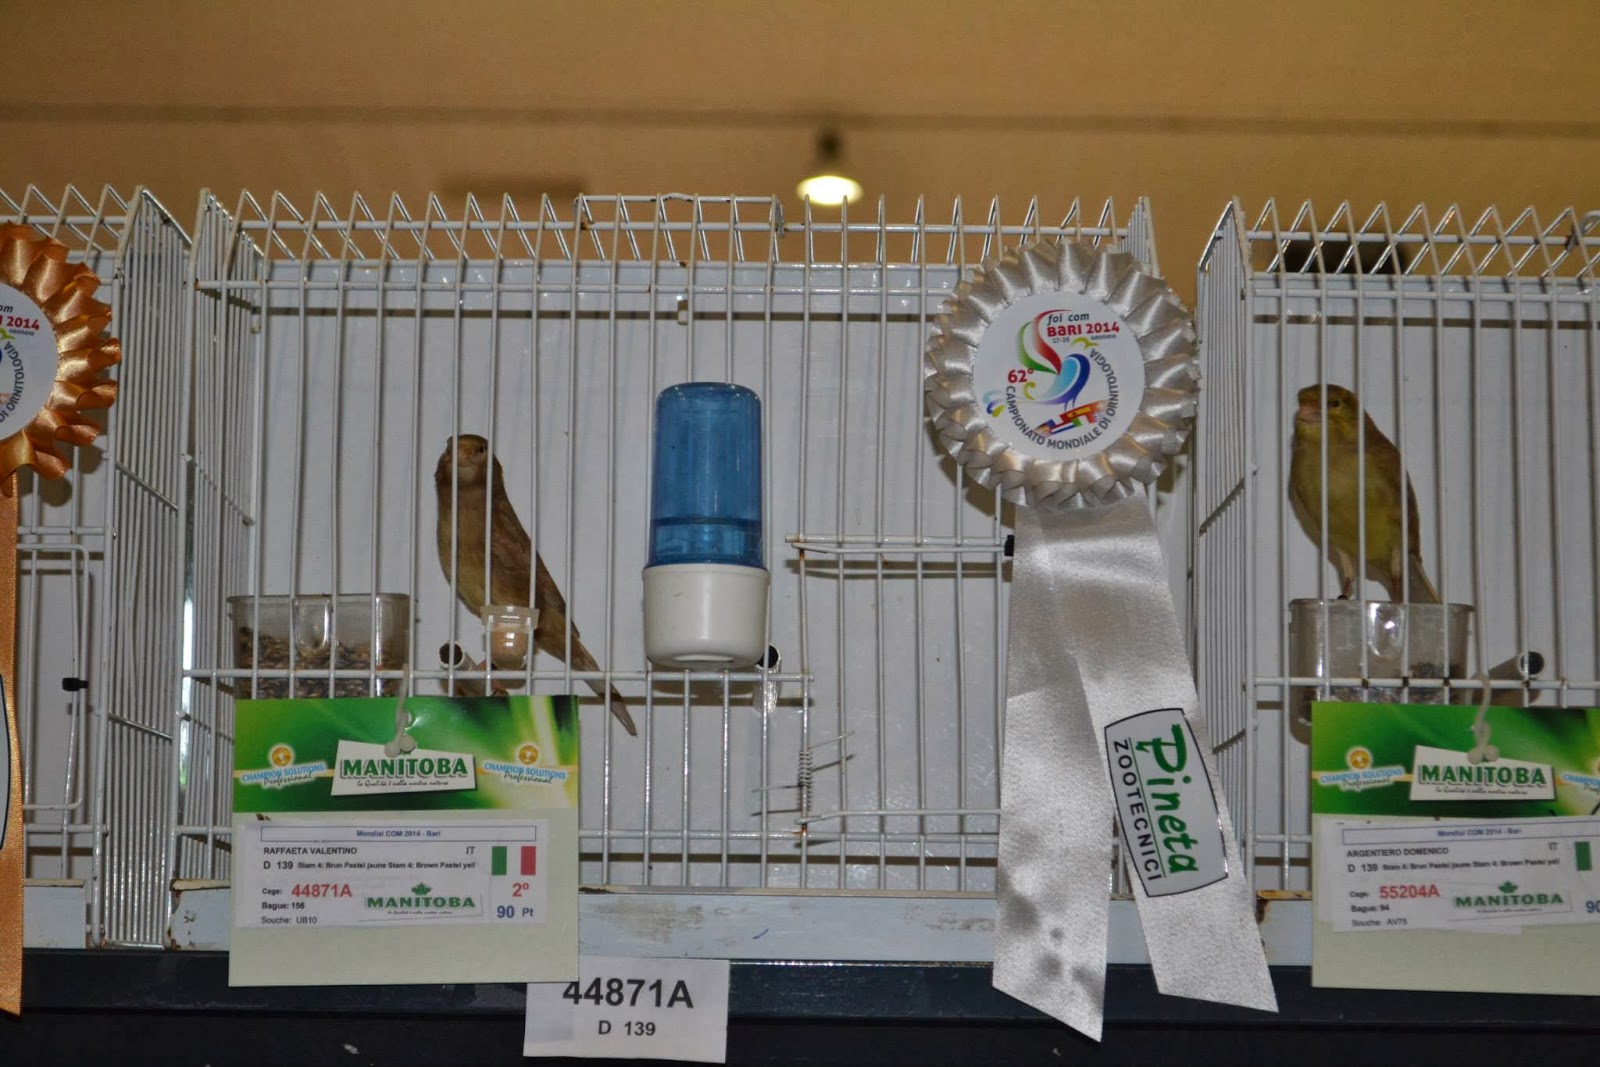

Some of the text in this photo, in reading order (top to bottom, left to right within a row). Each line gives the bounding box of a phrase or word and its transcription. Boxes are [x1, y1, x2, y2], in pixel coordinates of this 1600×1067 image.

[0, 304, 13, 313] om
[6, 315, 40, 331] 2014
[1047, 313, 1090, 326] foi com
[1086, 321, 1120, 334] 2014
[3, 341, 24, 411] ORNITOLOGIA
[1006, 348, 1120, 450] CAMPIONATO MONDIALE DI ORNITOLOGIA
[242, 763, 325, 782] CHAMPION SOLUTIONS
[341, 758, 468, 777] MANITOBA
[484, 762, 566, 779] CHAMPION SOLUTIONS
[1420, 765, 1547, 786] MANITOBA
[1136, 724, 1199, 874] Pineta
[1113, 739, 1163, 881] ZOOTECNICI
[310, 847, 358, 855] VALENTINO
[465, 846, 476, 855] IT
[1347, 847, 1449, 857] ARGENTIERO DOMENICO
[263, 861, 271, 870] D
[277, 861, 293, 870] 139
[367, 862, 387, 870] jaune
[1348, 864, 1356, 873] D
[1361, 863, 1378, 872] 139
[262, 884, 353, 898] Cage: 44871A
[1379, 884, 1440, 899] 55204A
[261, 902, 289, 911] Bague:
[367, 897, 476, 908] MANITOBA
[1455, 894, 1564, 907] MANITOBA
[496, 905, 534, 918] 90 Pt
[1380, 904, 1390, 912] 94
[261, 916, 291, 924] Souche:
[562, 977, 694, 1009] 44871A
[598, 1020, 656, 1036] D 139
